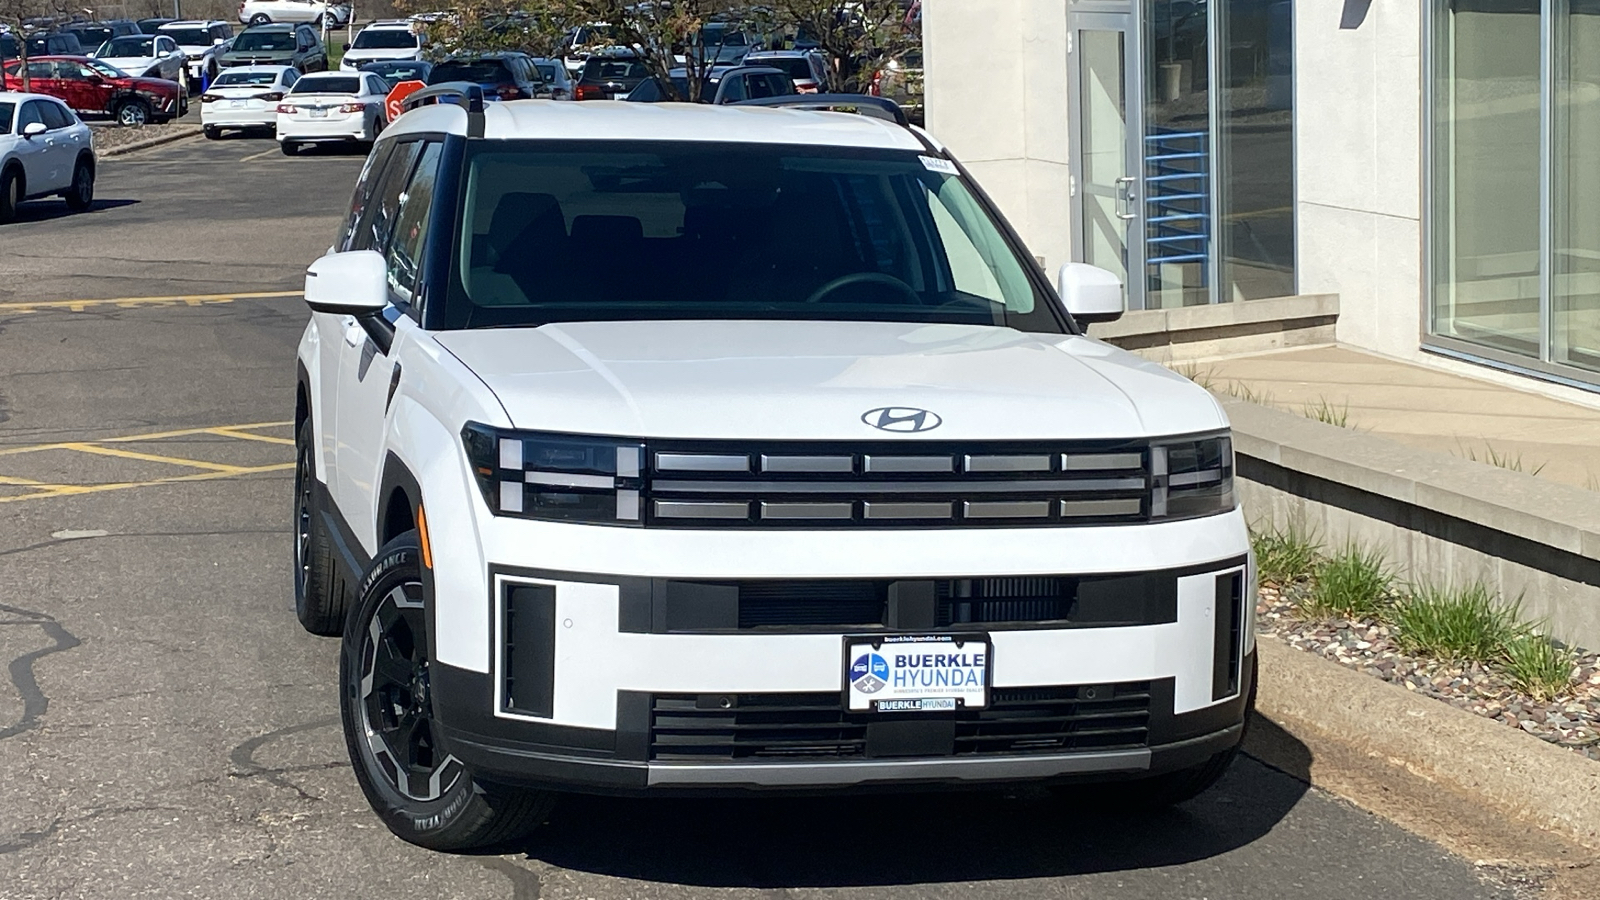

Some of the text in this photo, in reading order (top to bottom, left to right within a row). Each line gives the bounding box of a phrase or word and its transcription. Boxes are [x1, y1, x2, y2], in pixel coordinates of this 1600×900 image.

[895, 654, 984, 668] BUERKLE
[894, 669, 984, 687] HYUNDAI
[880, 699, 954, 710] BUERKLE HYUNDAI
